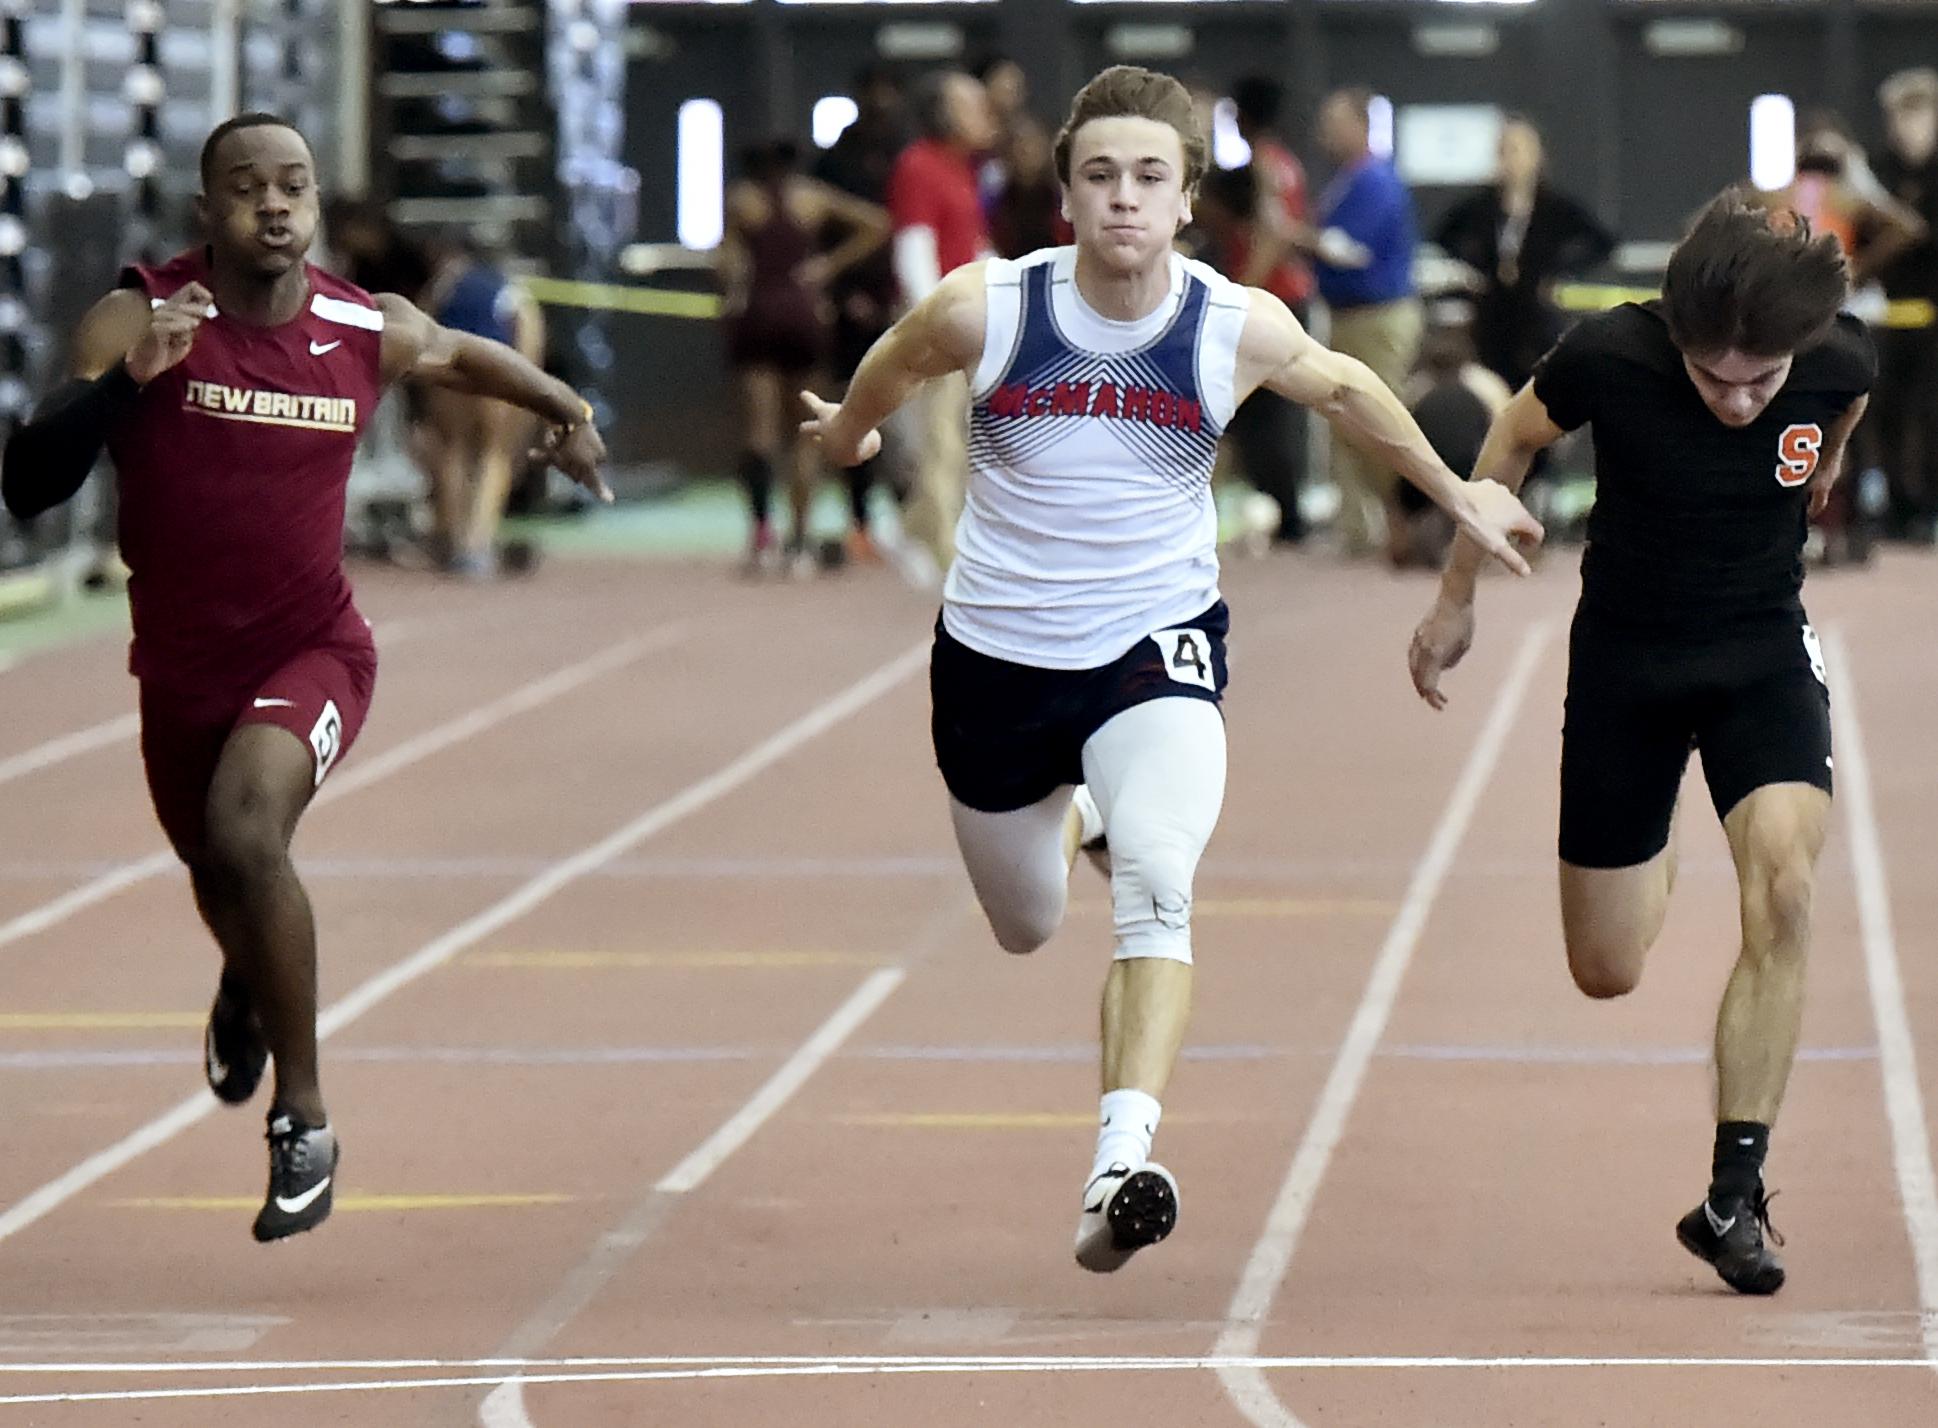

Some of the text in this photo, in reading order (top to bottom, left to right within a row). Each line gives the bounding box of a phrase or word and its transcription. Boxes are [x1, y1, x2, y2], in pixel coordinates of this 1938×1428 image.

[186, 380, 356, 424] NEW BRITAIN
[1774, 422, 1823, 488] S
[1172, 633, 1206, 681] 4
